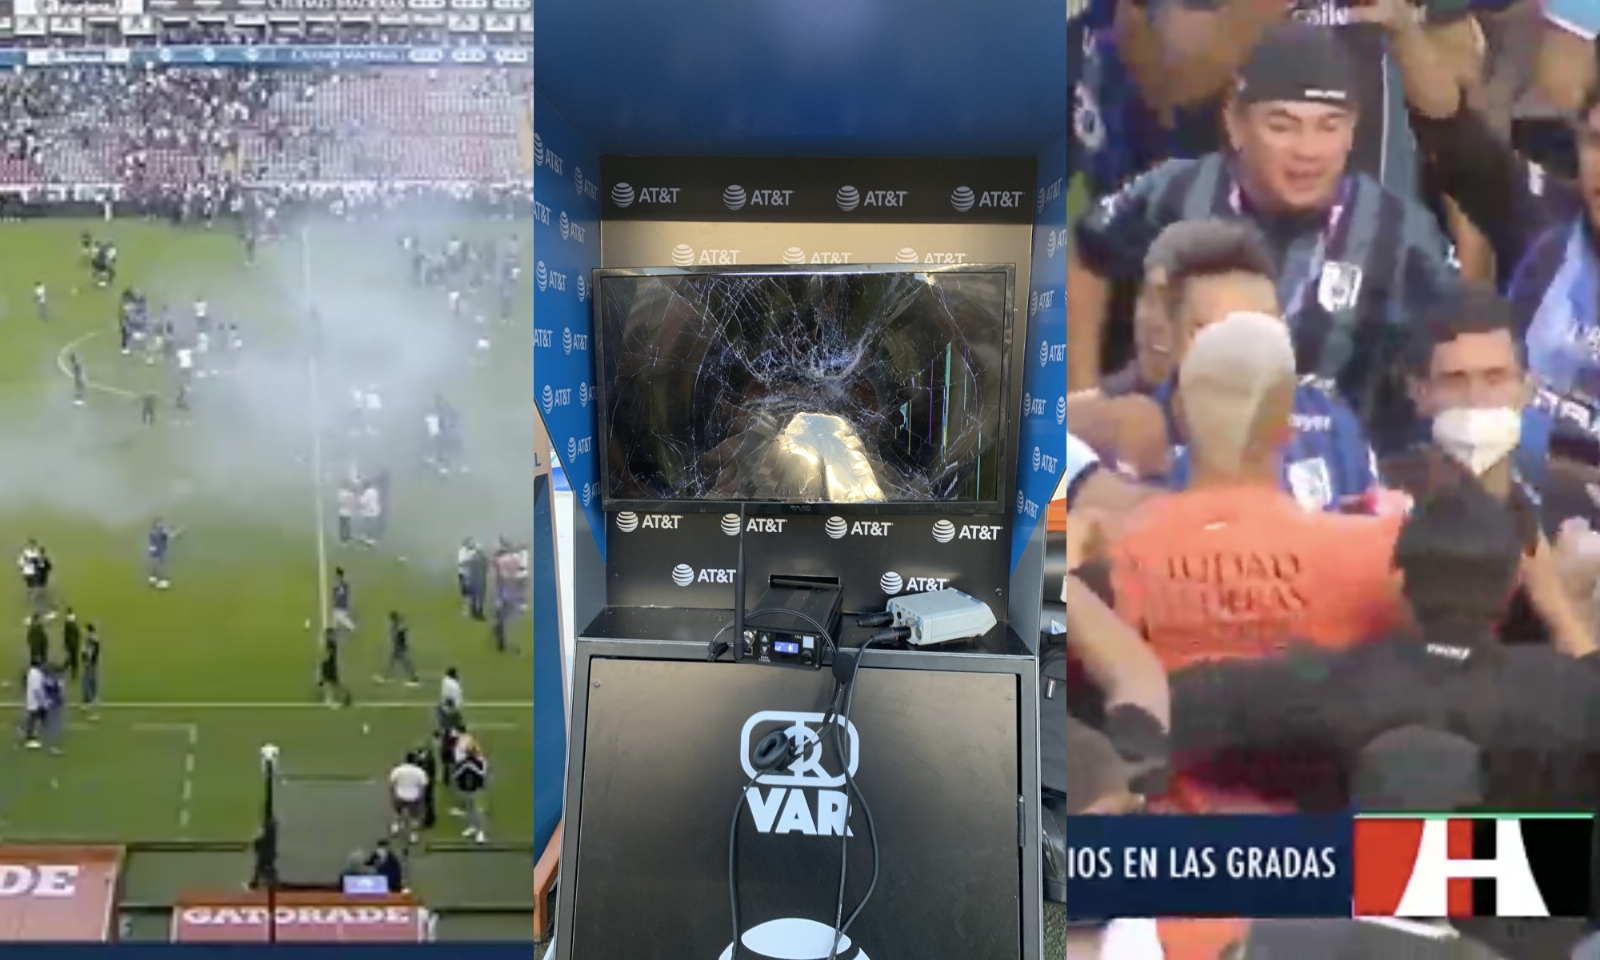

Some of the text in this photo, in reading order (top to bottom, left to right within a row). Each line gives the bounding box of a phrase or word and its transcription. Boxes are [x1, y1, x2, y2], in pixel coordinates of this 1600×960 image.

[545, 148, 564, 176] AT&T
[583, 179, 598, 201] AT&T
[638, 187, 680, 203] AT&T
[750, 189, 792, 206] AT&T
[863, 190, 907, 207] AT&T
[1046, 177, 1063, 204] AT&T
[978, 191, 1023, 208] AT&T
[570, 222, 586, 243] AT&T
[698, 249, 740, 265] AT&T
[810, 251, 852, 264] AT&T
[923, 252, 966, 264] AT&T
[549, 270, 567, 292] AT&T
[1039, 290, 1055, 310] AT&T
[573, 334, 588, 350] AT&T
[1049, 344, 1067, 362] AT&T
[554, 388, 572, 407] AT&T
[1031, 399, 1047, 416] AT&T
[577, 436, 592, 456] AT&T
[1041, 454, 1058, 474] AT&T
[1024, 498, 1039, 519] AT&T
[641, 514, 681, 529] AT&T
[746, 518, 786, 533] AT&T
[850, 521, 892, 537] AT&T
[958, 525, 1001, 541] AT&T
[697, 568, 736, 584] AT&T
[906, 576, 946, 592] AT&T
[743, 786, 854, 837] VAR
[183, 907, 409, 924] GATORADE
